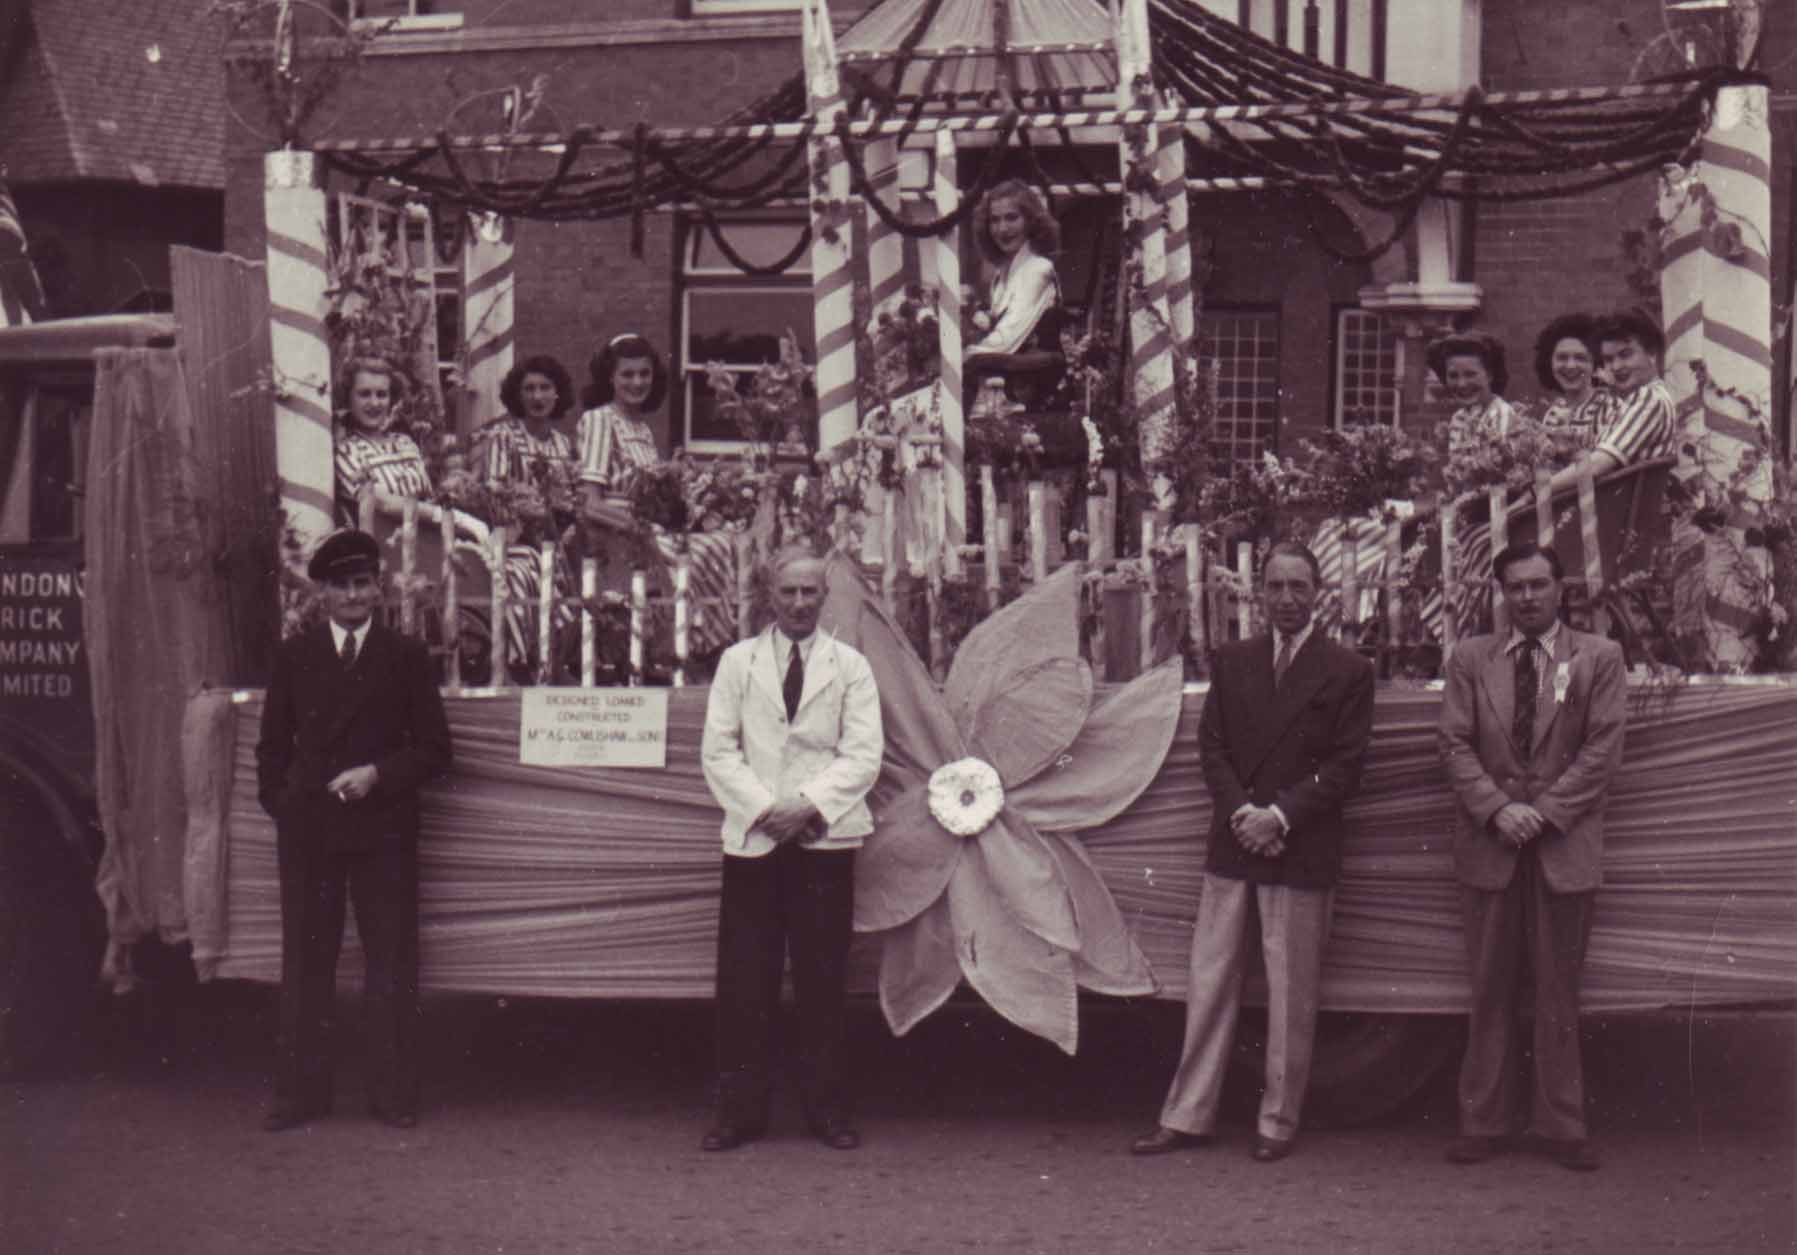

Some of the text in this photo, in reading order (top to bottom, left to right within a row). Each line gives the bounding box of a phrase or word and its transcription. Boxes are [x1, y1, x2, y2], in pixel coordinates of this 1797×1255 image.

[1, 572, 72, 598] NDON
[0, 606, 64, 631] RICK
[0, 640, 81, 664] MPANY
[3, 673, 72, 697] MITED
